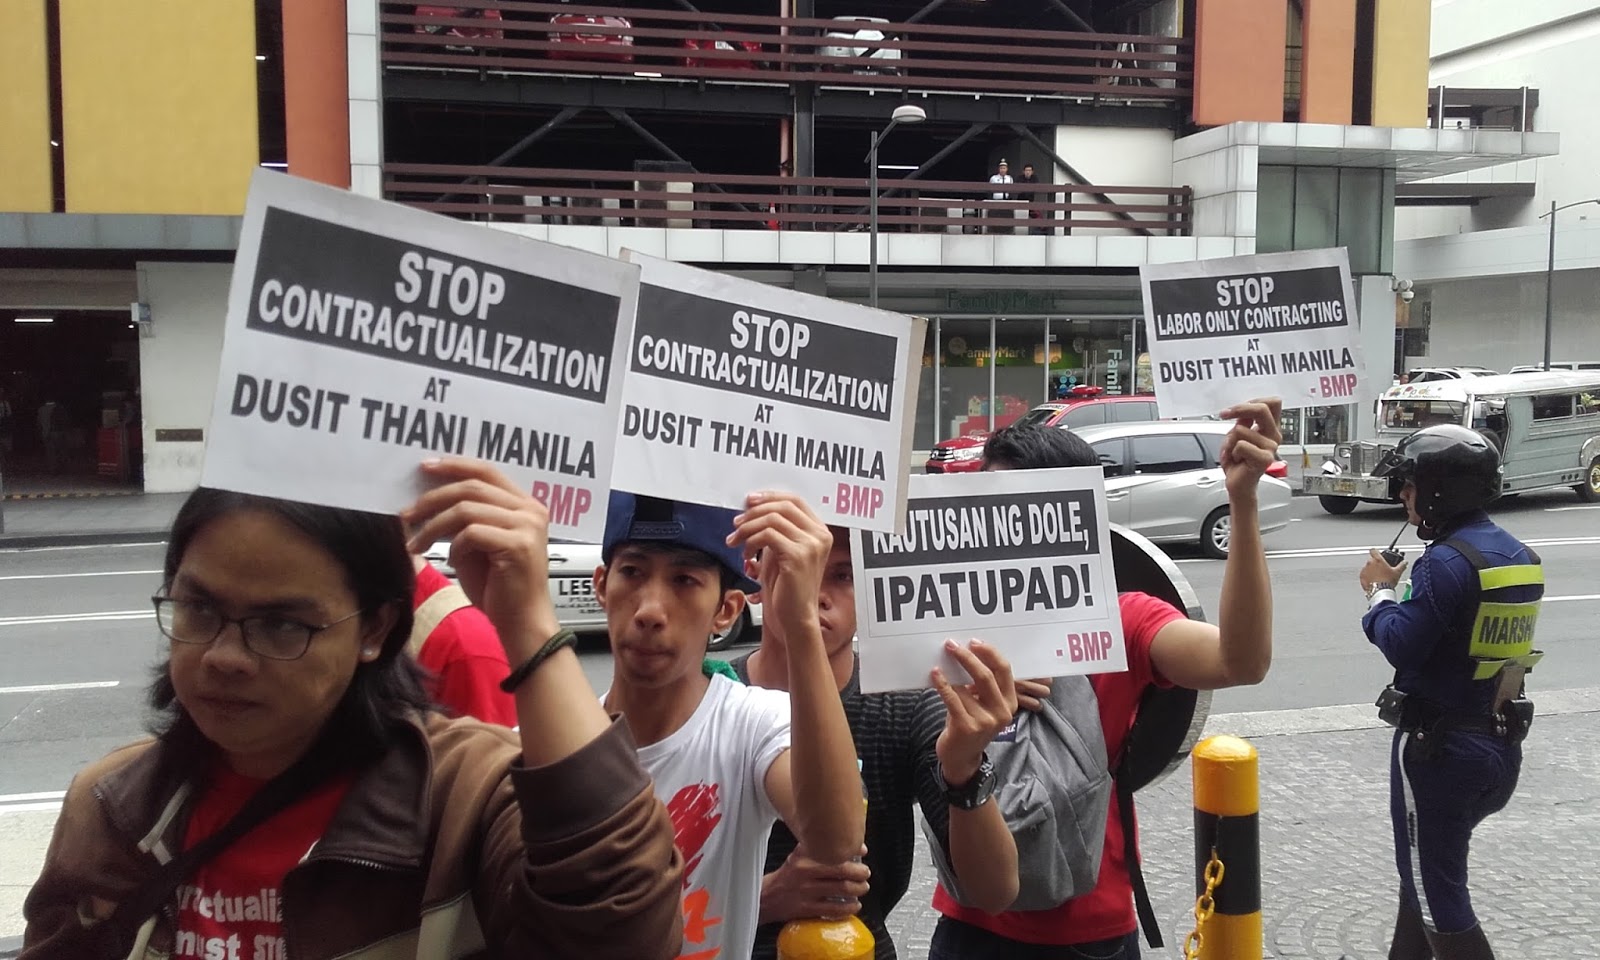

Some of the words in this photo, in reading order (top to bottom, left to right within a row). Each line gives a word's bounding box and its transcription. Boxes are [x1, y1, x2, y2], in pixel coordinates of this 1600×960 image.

[394, 250, 506, 320] STOP
[946, 289, 1057, 312] FamilyMart
[1216, 276, 1275, 307] STOP
[257, 278, 606, 393] CONTRACTUALIZATION
[729, 310, 810, 360] STOP
[1157, 312, 1203, 336] LABOR
[1205, 309, 1241, 333] ONLY
[1244, 300, 1343, 330] CONTRACTING
[1247, 338, 1260, 352] AT
[637, 334, 889, 413] CONTRACTUALIZATION
[1106, 349, 1123, 395] Famil
[1159, 358, 1214, 383] DUSIT
[1218, 353, 1276, 378] THANI
[1282, 347, 1355, 374] MANILA
[423, 376, 450, 403] AT
[1320, 373, 1358, 398] BMP
[230, 374, 349, 434] DUSIT
[360, 397, 469, 456] THANI
[476, 421, 597, 479] MANILA
[754, 403, 774, 425] AT
[623, 404, 702, 448] DUSIT
[710, 420, 787, 463] THANI
[795, 436, 886, 481] MANILA
[835, 482, 884, 519] BMP
[992, 503, 1025, 547] NG
[1027, 501, 1090, 551] DOLE,
[558, 580, 597, 596] LES
[873, 563, 1094, 623] IPATUPAD!
[1067, 631, 1112, 663] BMP
[1478, 615, 1536, 645] MARSH
